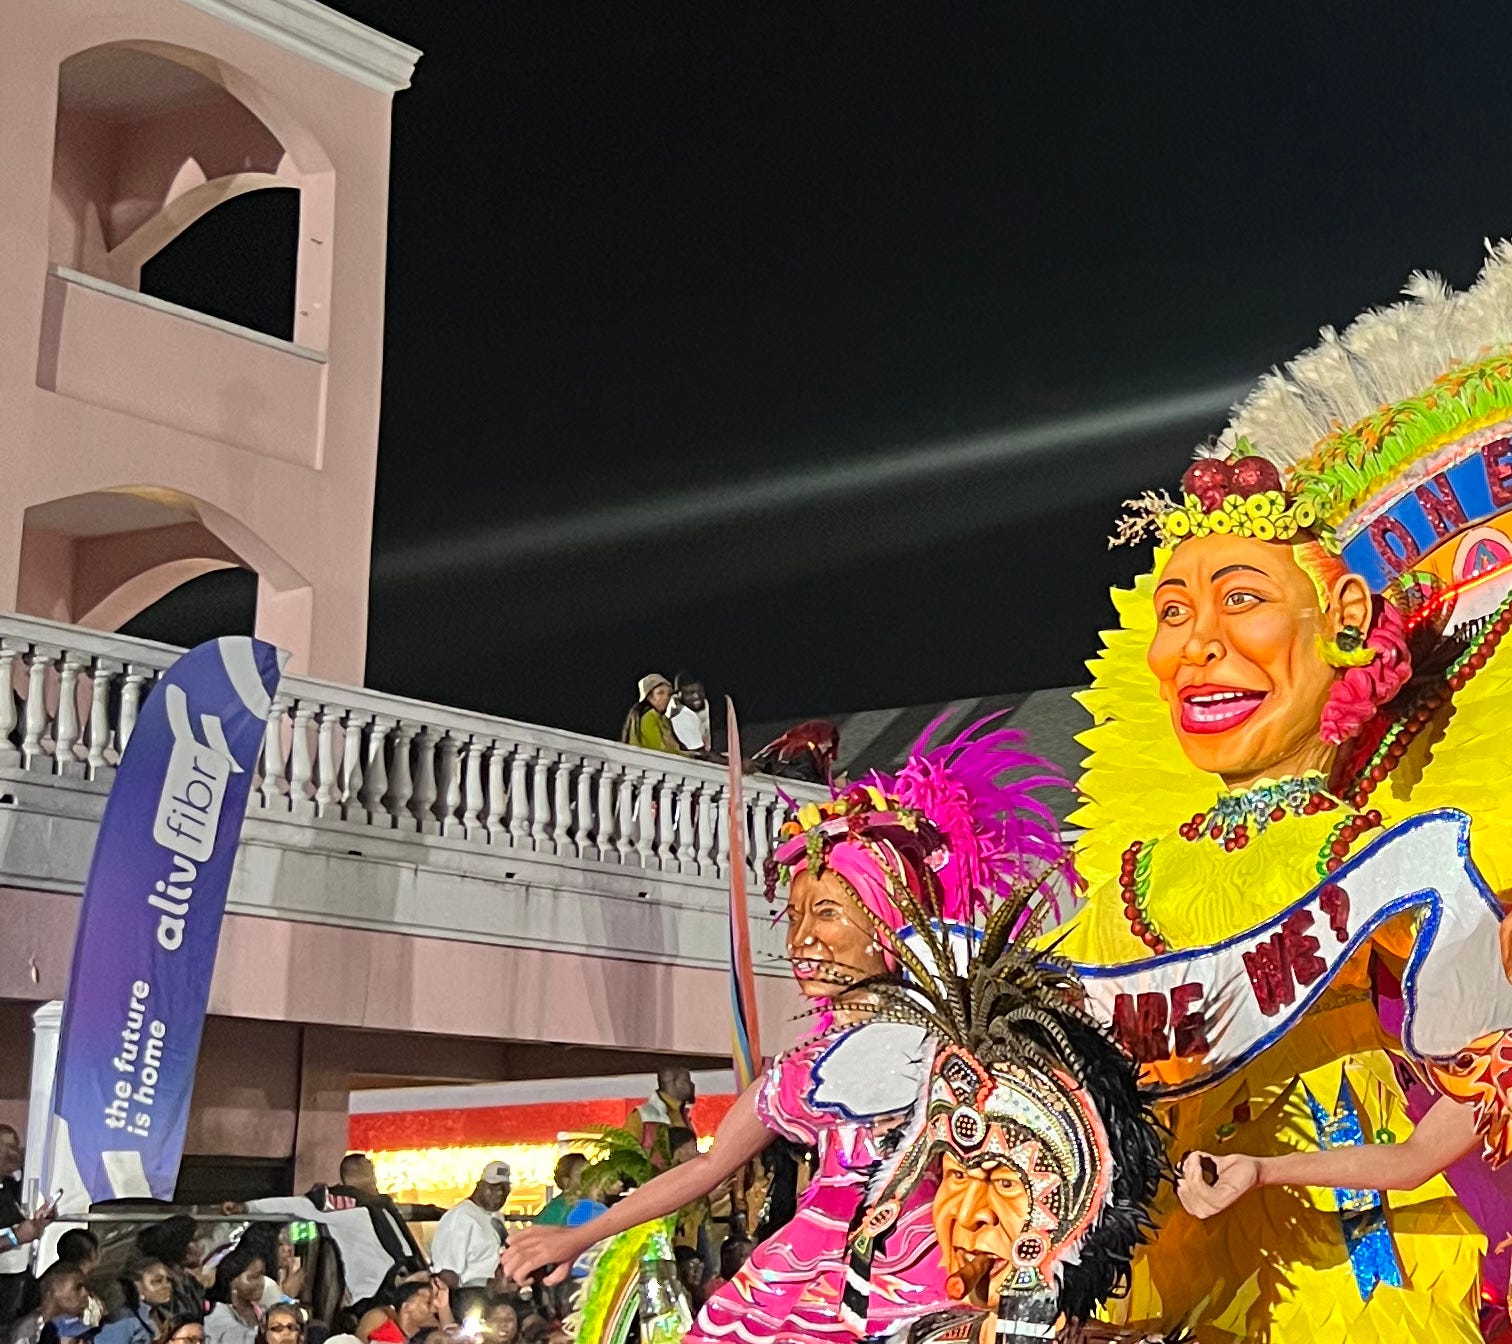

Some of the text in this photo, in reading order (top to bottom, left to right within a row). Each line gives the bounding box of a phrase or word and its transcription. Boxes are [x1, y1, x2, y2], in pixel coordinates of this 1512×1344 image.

[105, 979, 151, 1130] the future
[126, 1019, 167, 1137] is home
[1112, 982, 1210, 1061] ARE
